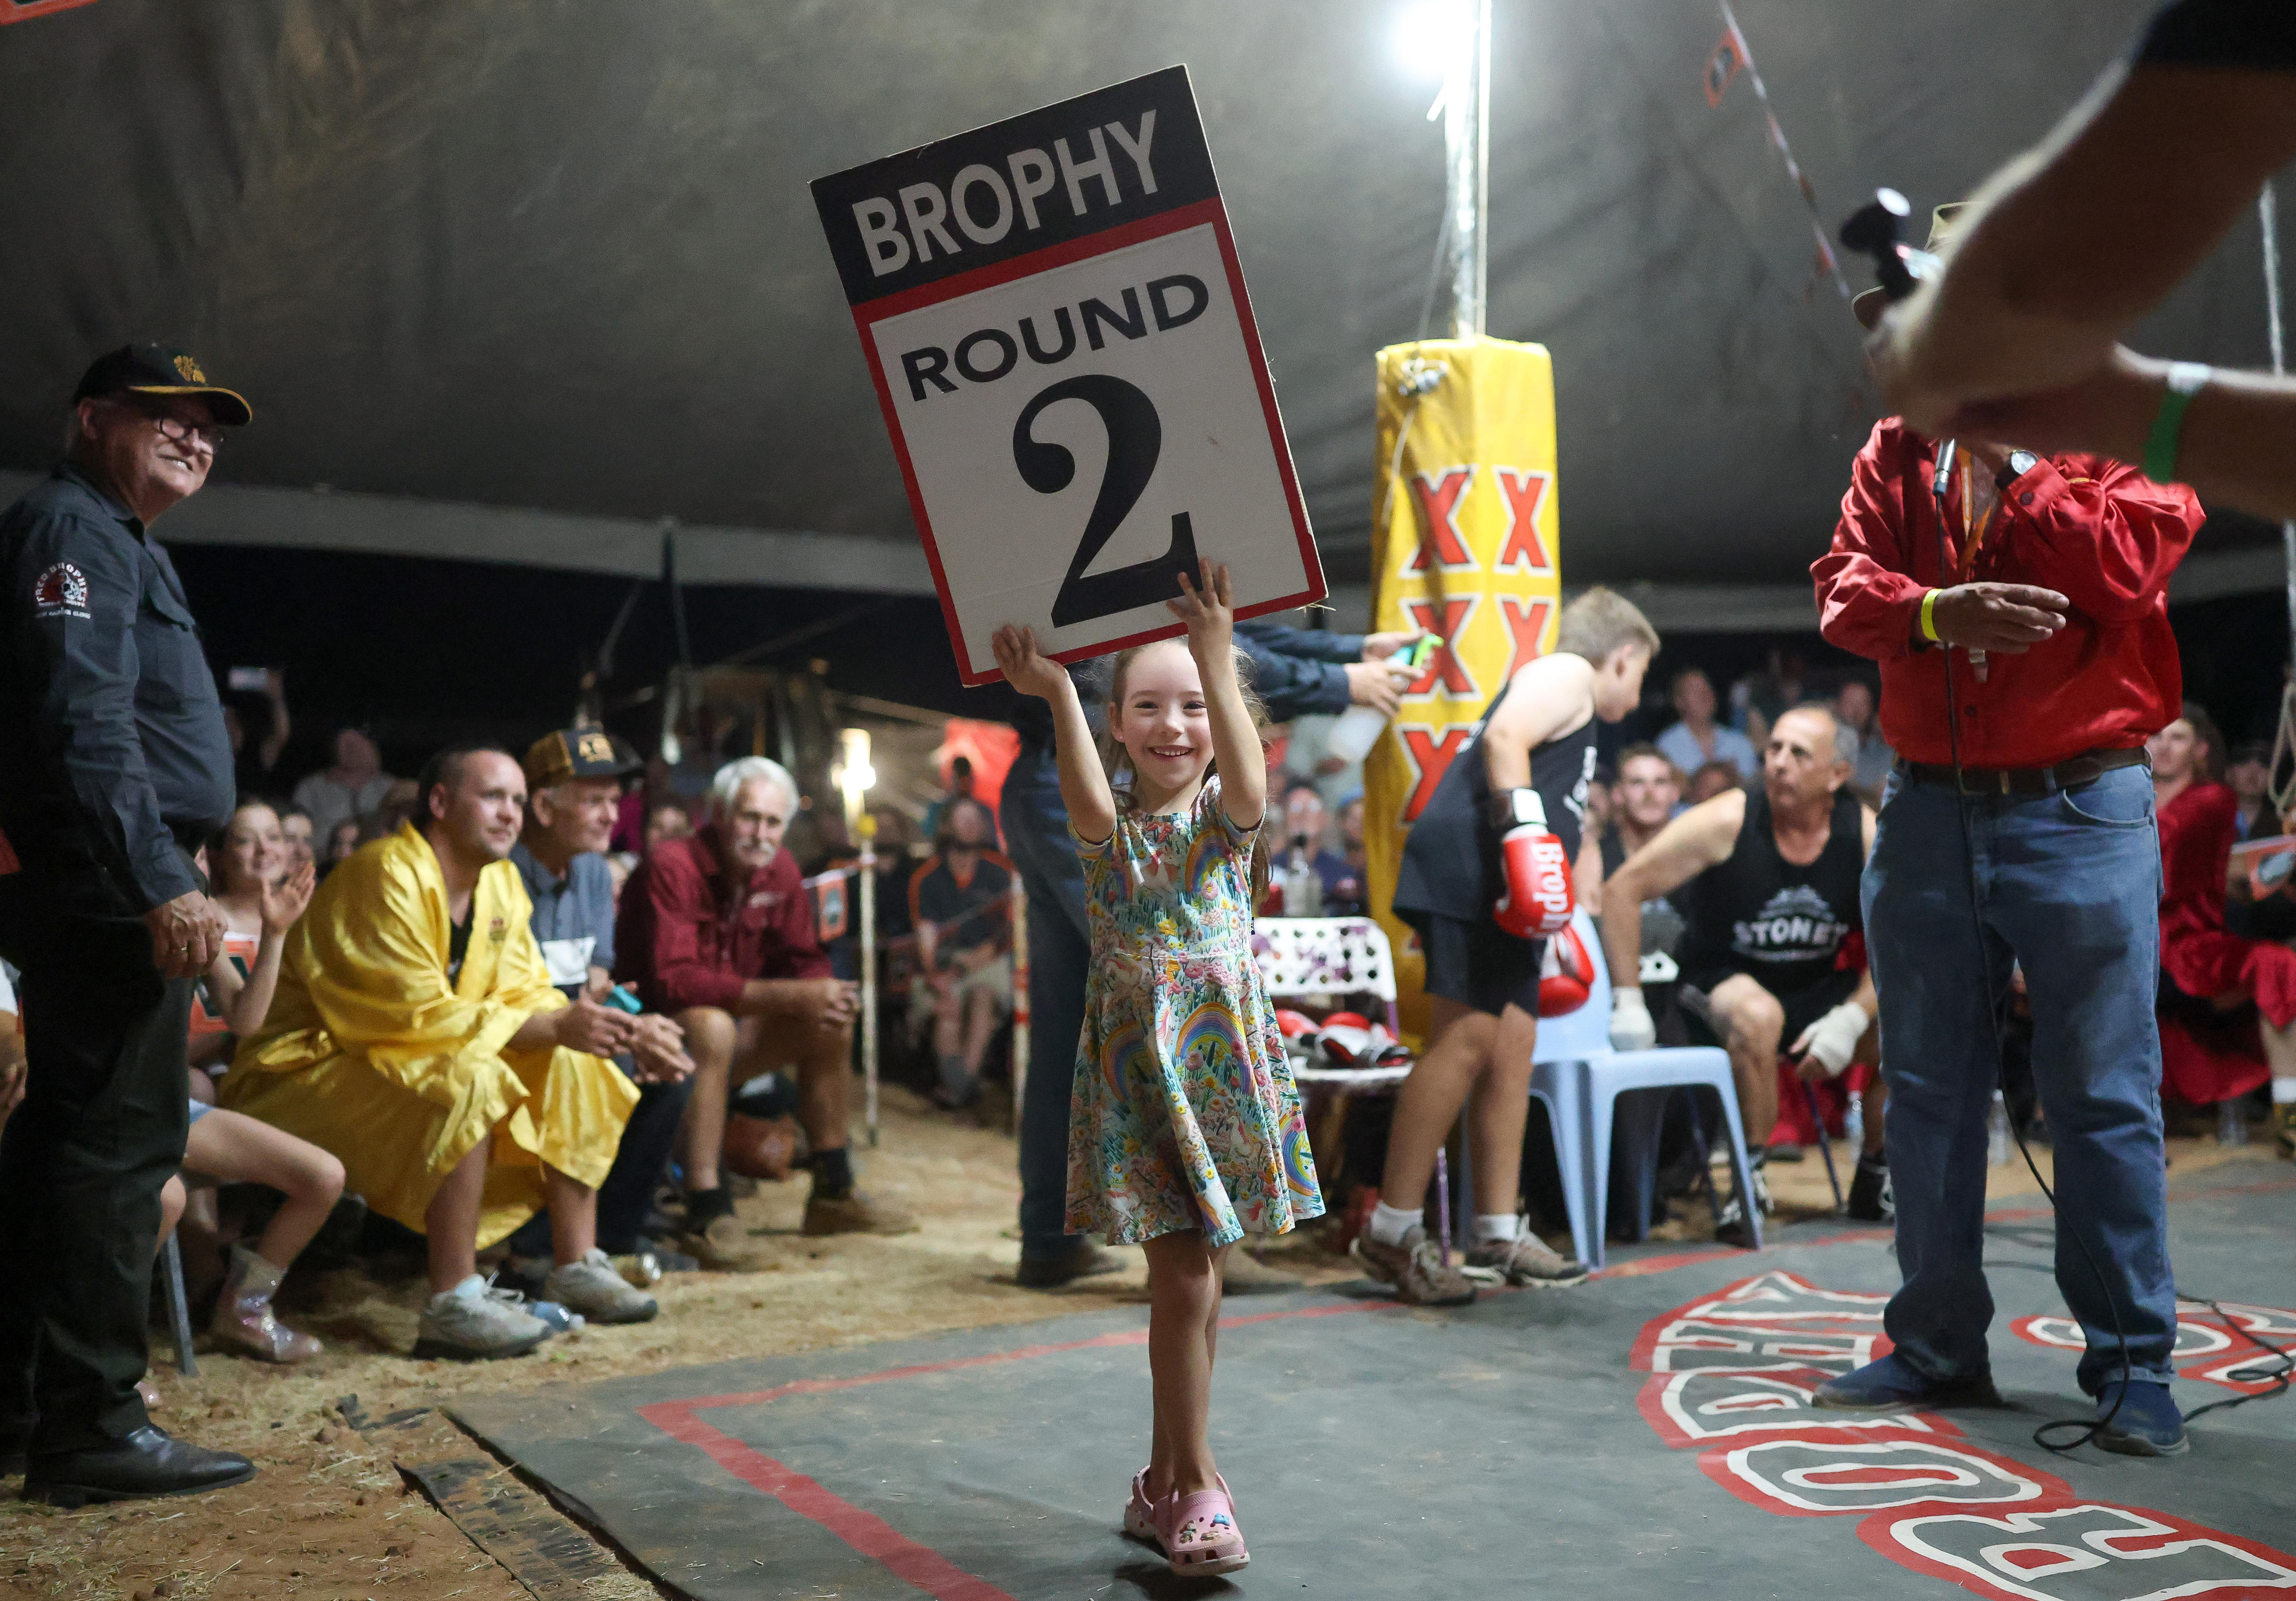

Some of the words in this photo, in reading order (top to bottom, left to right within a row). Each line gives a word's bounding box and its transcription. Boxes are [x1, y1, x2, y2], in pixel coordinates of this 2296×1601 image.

[852, 109, 1158, 277] BROPHY
[900, 274, 1210, 402] ROUND
[1013, 373, 1203, 628] 2
